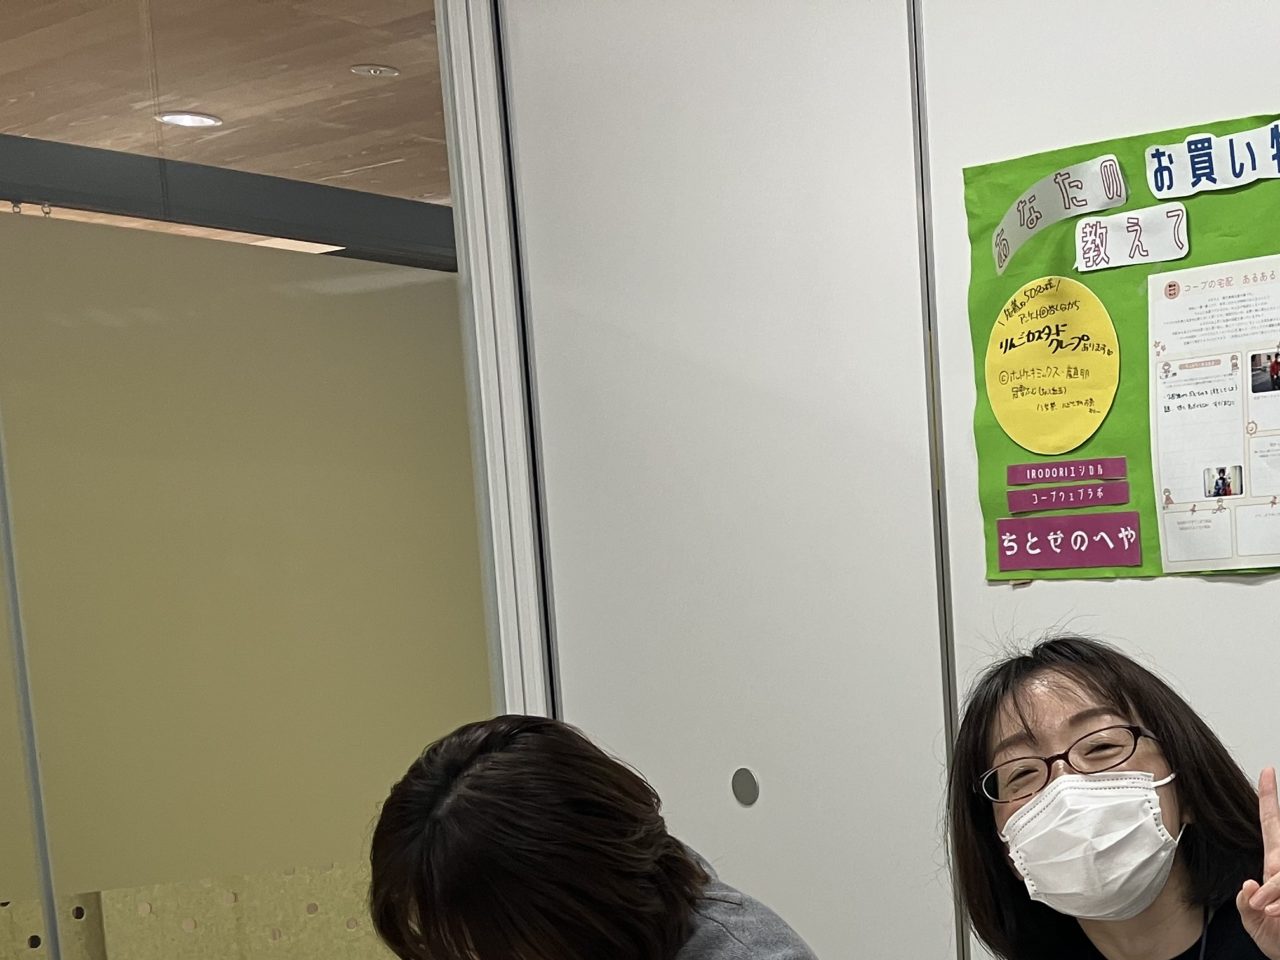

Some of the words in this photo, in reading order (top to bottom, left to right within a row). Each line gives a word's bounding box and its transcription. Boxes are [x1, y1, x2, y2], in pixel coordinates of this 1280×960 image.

[994, 158, 1123, 269] あなたの
[1080, 208, 1185, 268] 教えて
[1184, 276, 1235, 293] コープの宅配
[1026, 464, 1103, 479] IRODORIエシカル
[1031, 486, 1104, 504] コープウェブラボ
